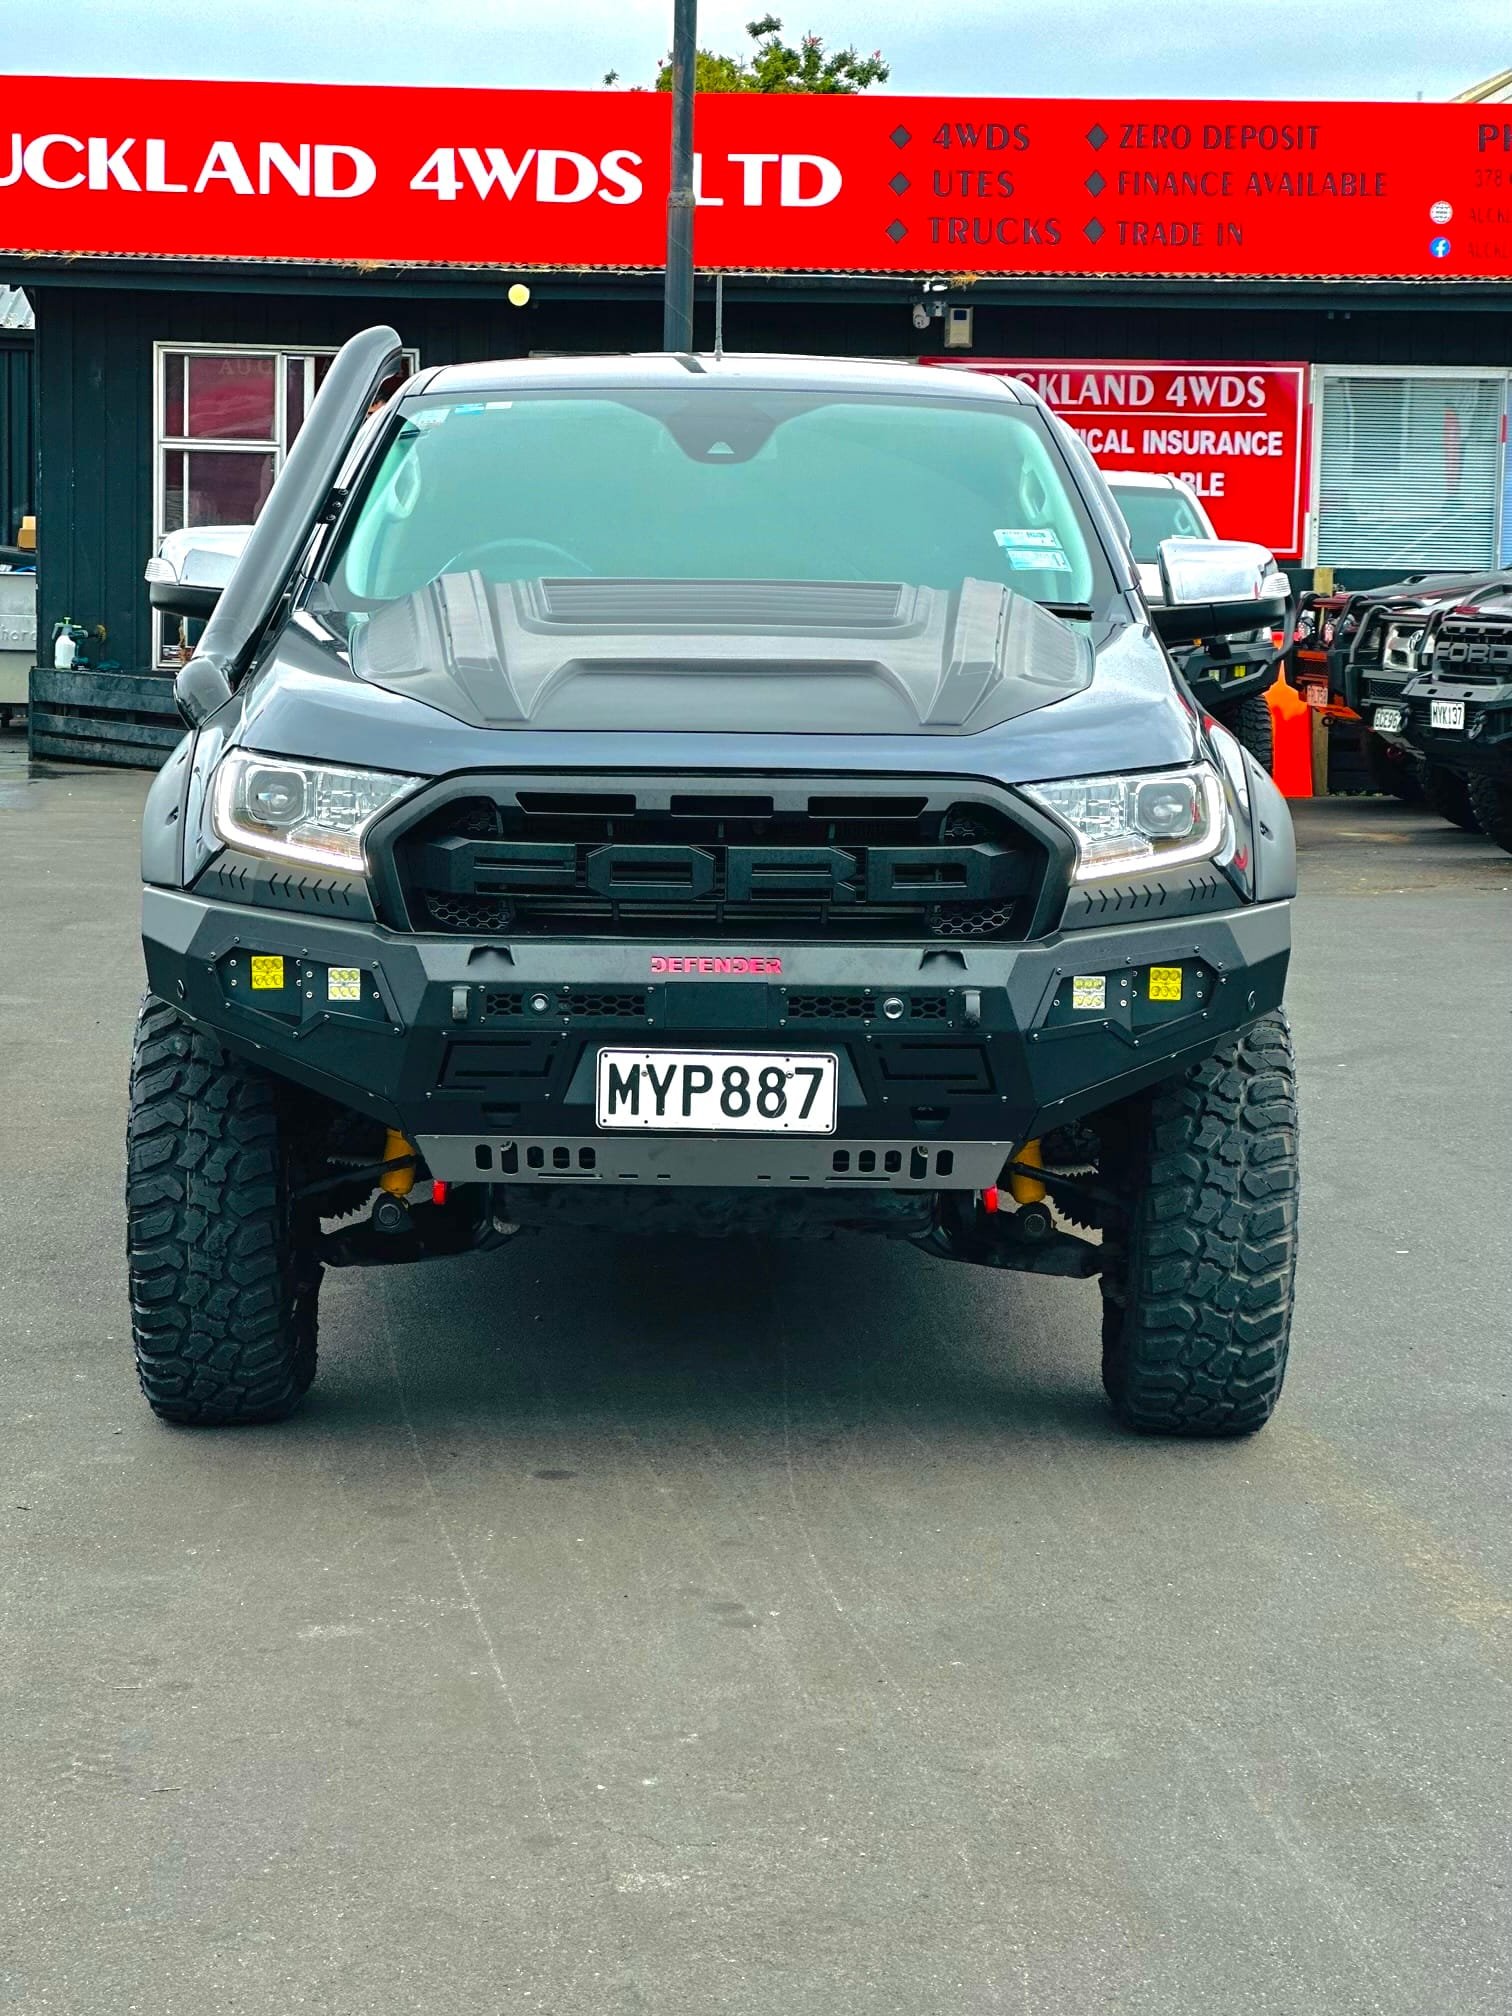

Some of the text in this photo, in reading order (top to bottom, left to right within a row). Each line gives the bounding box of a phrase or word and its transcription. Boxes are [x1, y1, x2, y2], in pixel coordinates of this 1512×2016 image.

[932, 122, 1030, 152] 4WDS
[1119, 123, 1320, 151] ZERO DEPOSIT
[410, 147, 643, 205] 4WDS
[694, 152, 843, 207] LTD
[932, 169, 1015, 198] UTES
[1117, 170, 1388, 198] FINANCE AVAILABLE
[928, 216, 1062, 246] TRUCKS
[1117, 220, 1243, 247] TRADE IN
[1166, 375, 1266, 408] 4WDS
[1142, 429, 1283, 456] INSURANCE
[651, 956, 782, 974] DEFENDER
[607, 1062, 824, 1119] MYP887
